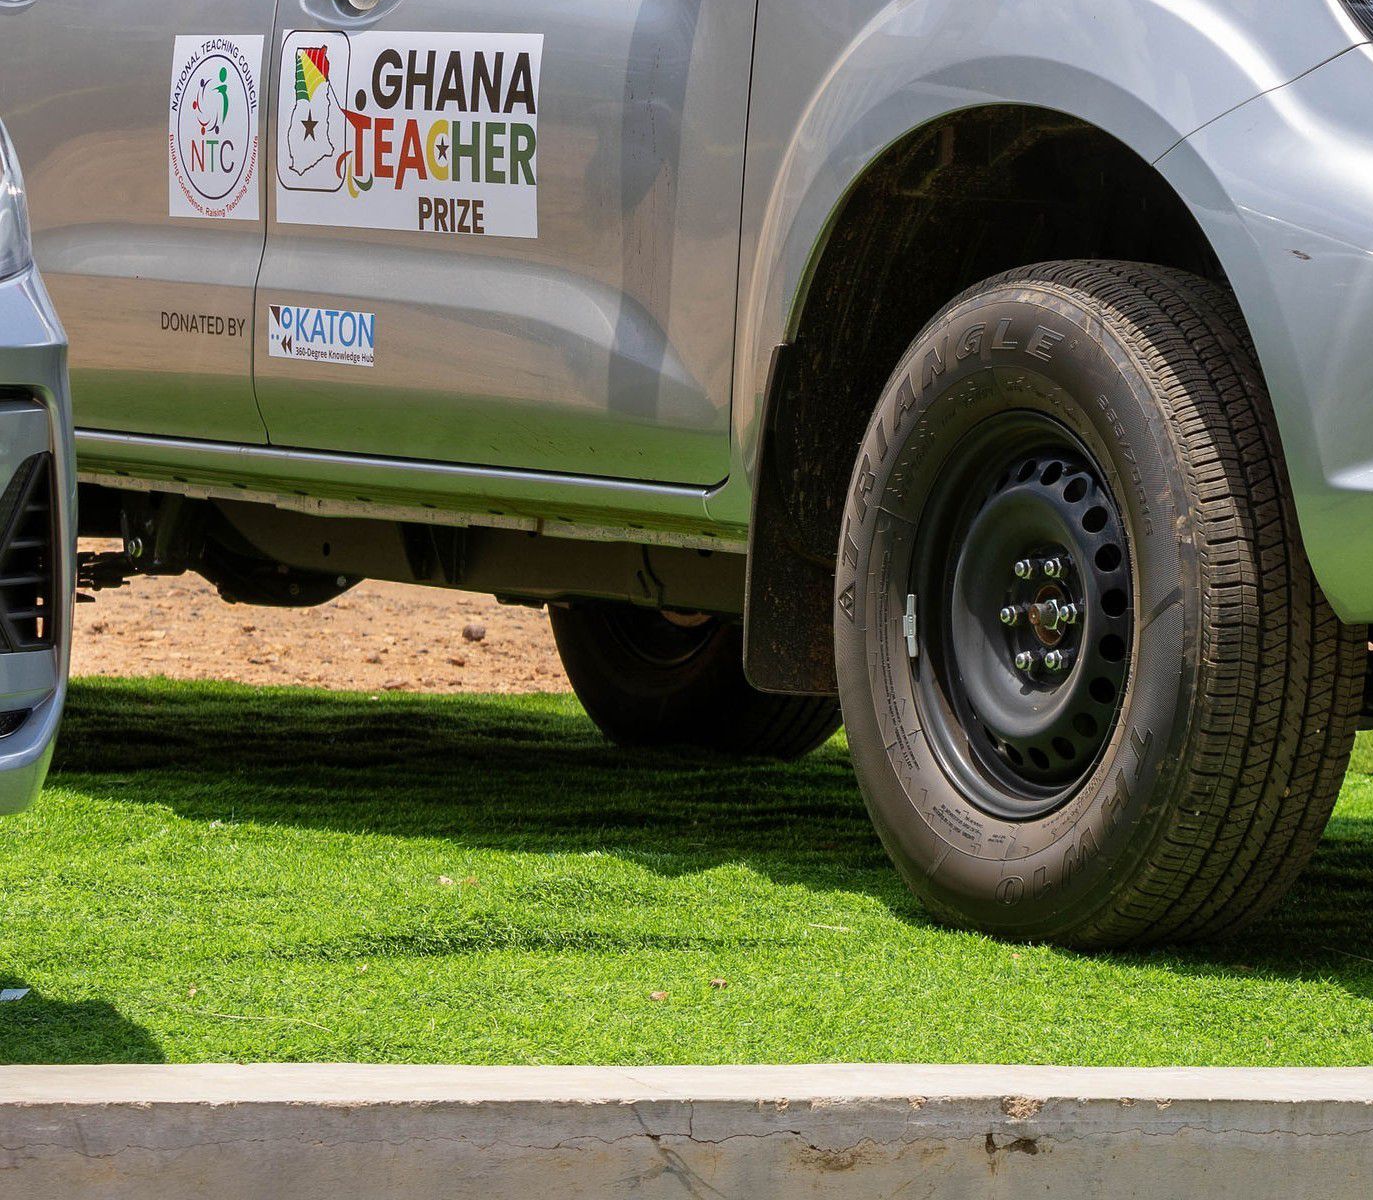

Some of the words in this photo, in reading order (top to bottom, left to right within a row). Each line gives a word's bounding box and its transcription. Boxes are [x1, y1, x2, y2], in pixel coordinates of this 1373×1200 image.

[171, 51, 200, 111] NATIONAL
[201, 38, 239, 59] TEACHING
[238, 55, 257, 113] COUNCIL
[371, 48, 537, 115] GHANA
[191, 139, 235, 174] NTC
[341, 108, 537, 191] TEACHER
[418, 197, 485, 235] PRIZE
[161, 311, 224, 336] DONATED
[228, 317, 246, 338] BY
[295, 346, 327, 360] 360-Degree
[328, 349, 361, 363] Knowledge
[361, 353, 375, 363] Hub
[842, 317, 1066, 571] TRIANGLE
